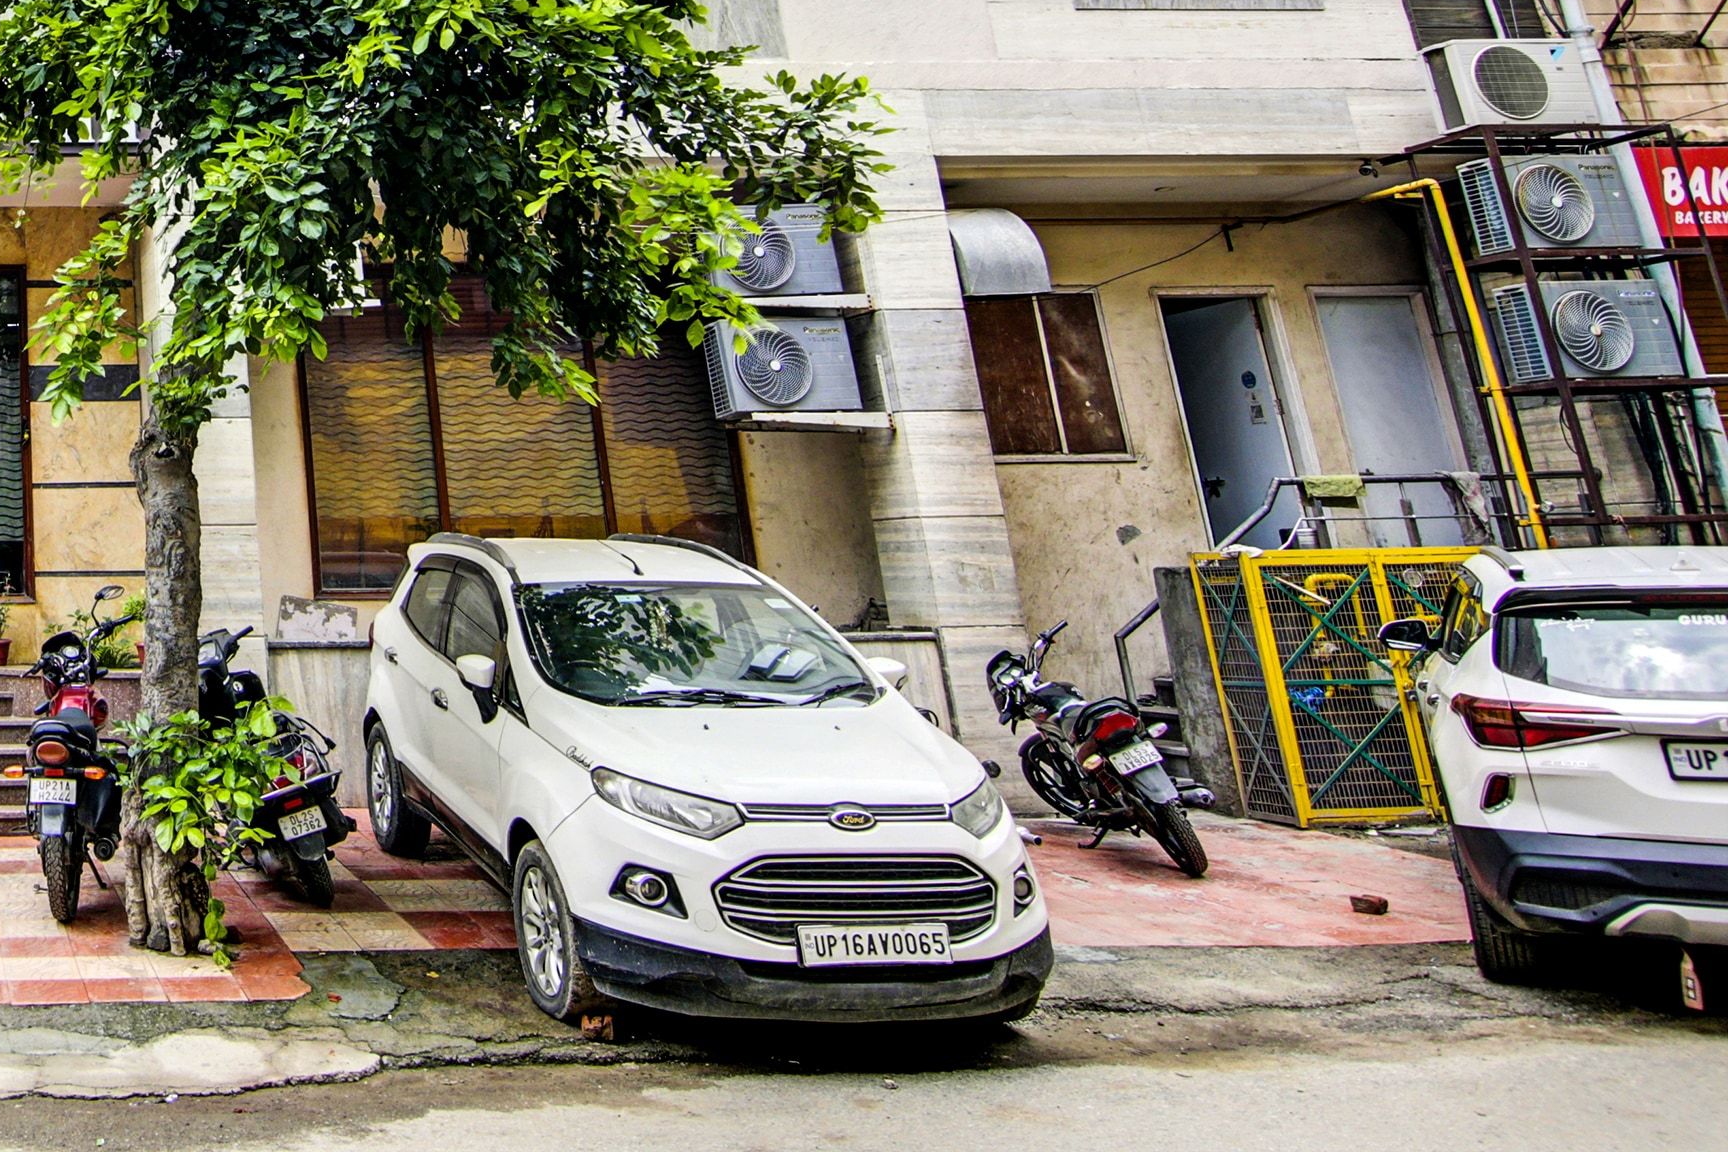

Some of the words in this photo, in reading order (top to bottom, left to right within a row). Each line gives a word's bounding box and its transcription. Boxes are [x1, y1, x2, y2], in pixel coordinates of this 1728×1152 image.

[1661, 165, 1728, 207] BAK
[39, 780, 71, 791] UP21A
[39, 791, 71, 802] H2444
[289, 809, 315, 826] DL2S
[842, 814, 865, 825] Ford
[291, 818, 322, 836] 07362
[814, 932, 946, 957] UP16AV0065
